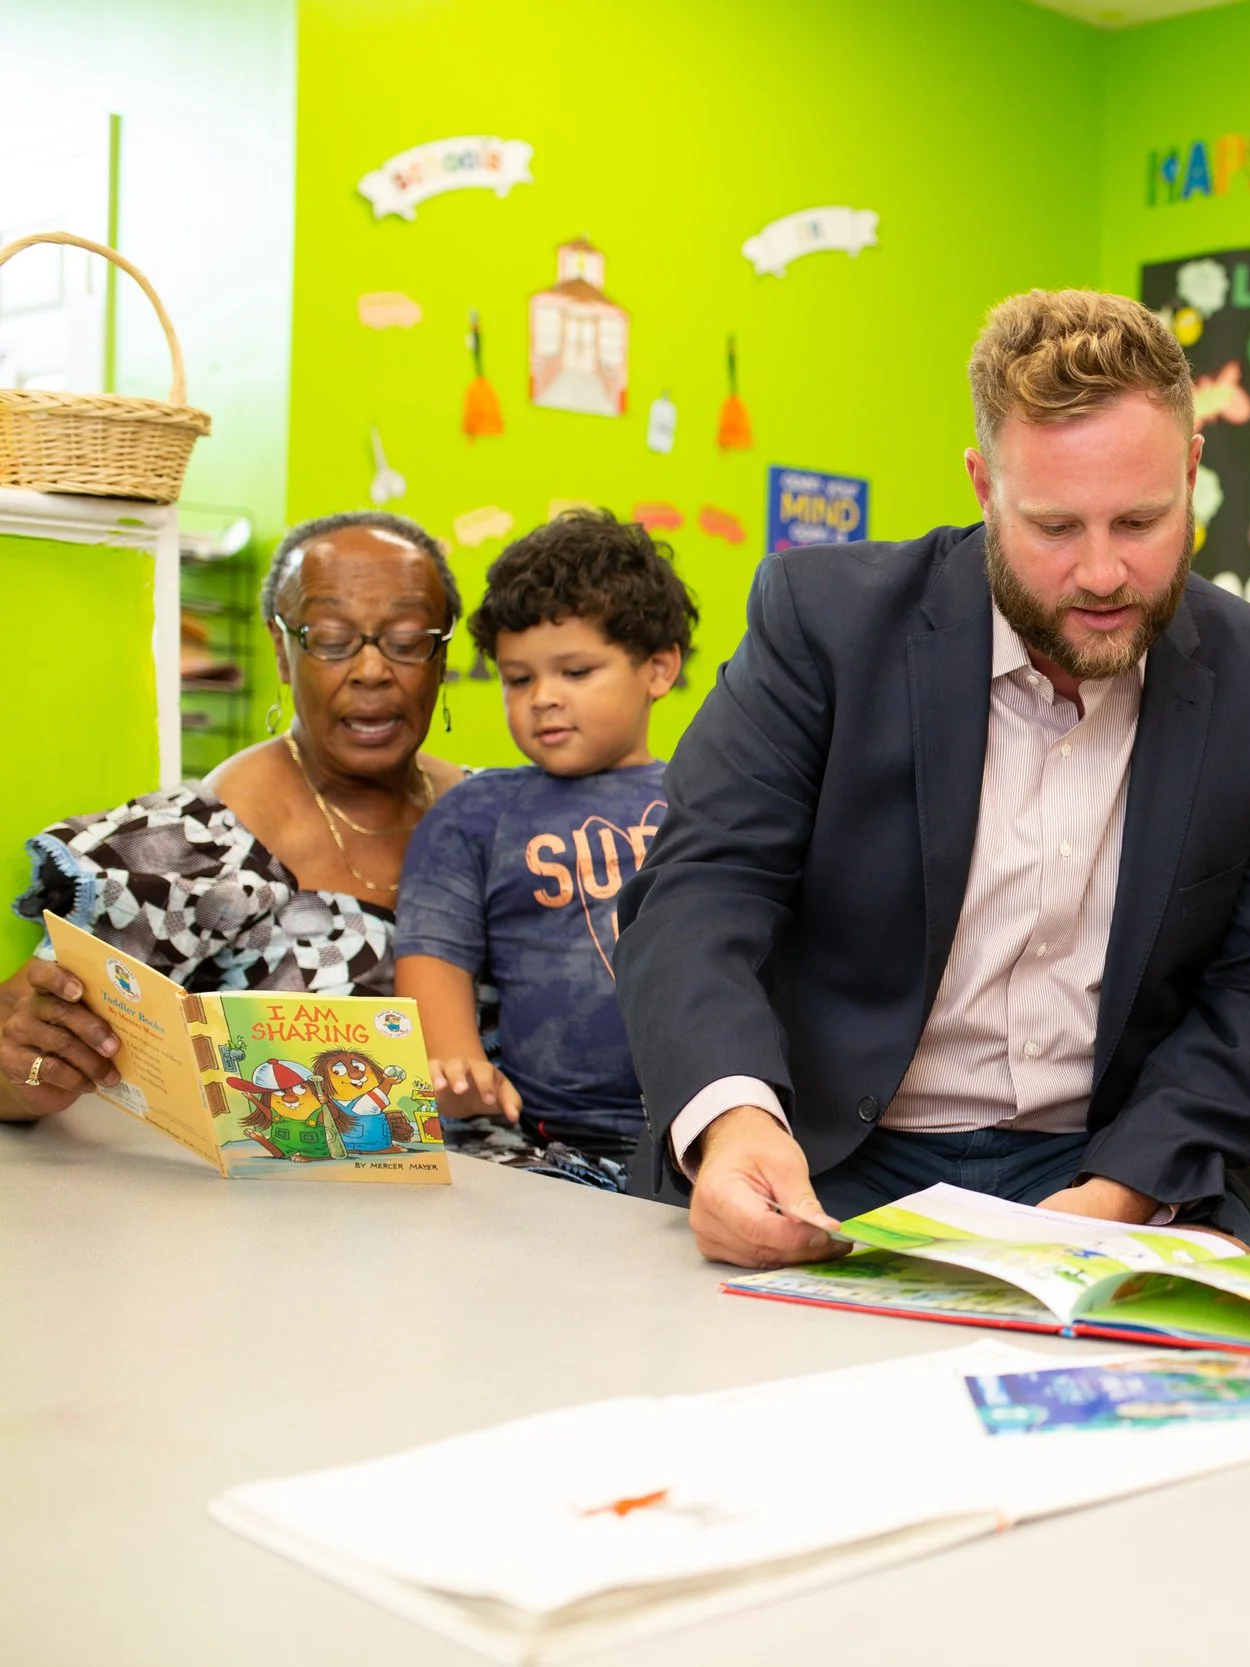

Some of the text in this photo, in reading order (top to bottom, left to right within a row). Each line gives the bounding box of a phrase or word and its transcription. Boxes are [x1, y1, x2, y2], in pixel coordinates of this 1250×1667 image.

[779, 490, 861, 533] MIND
[101, 990, 136, 1017] Toddler
[137, 1011, 166, 1035] Books
[266, 1004, 339, 1023] I AM
[251, 1022, 370, 1044] SHARING
[354, 1161, 439, 1171] BY MERCER MAYER
